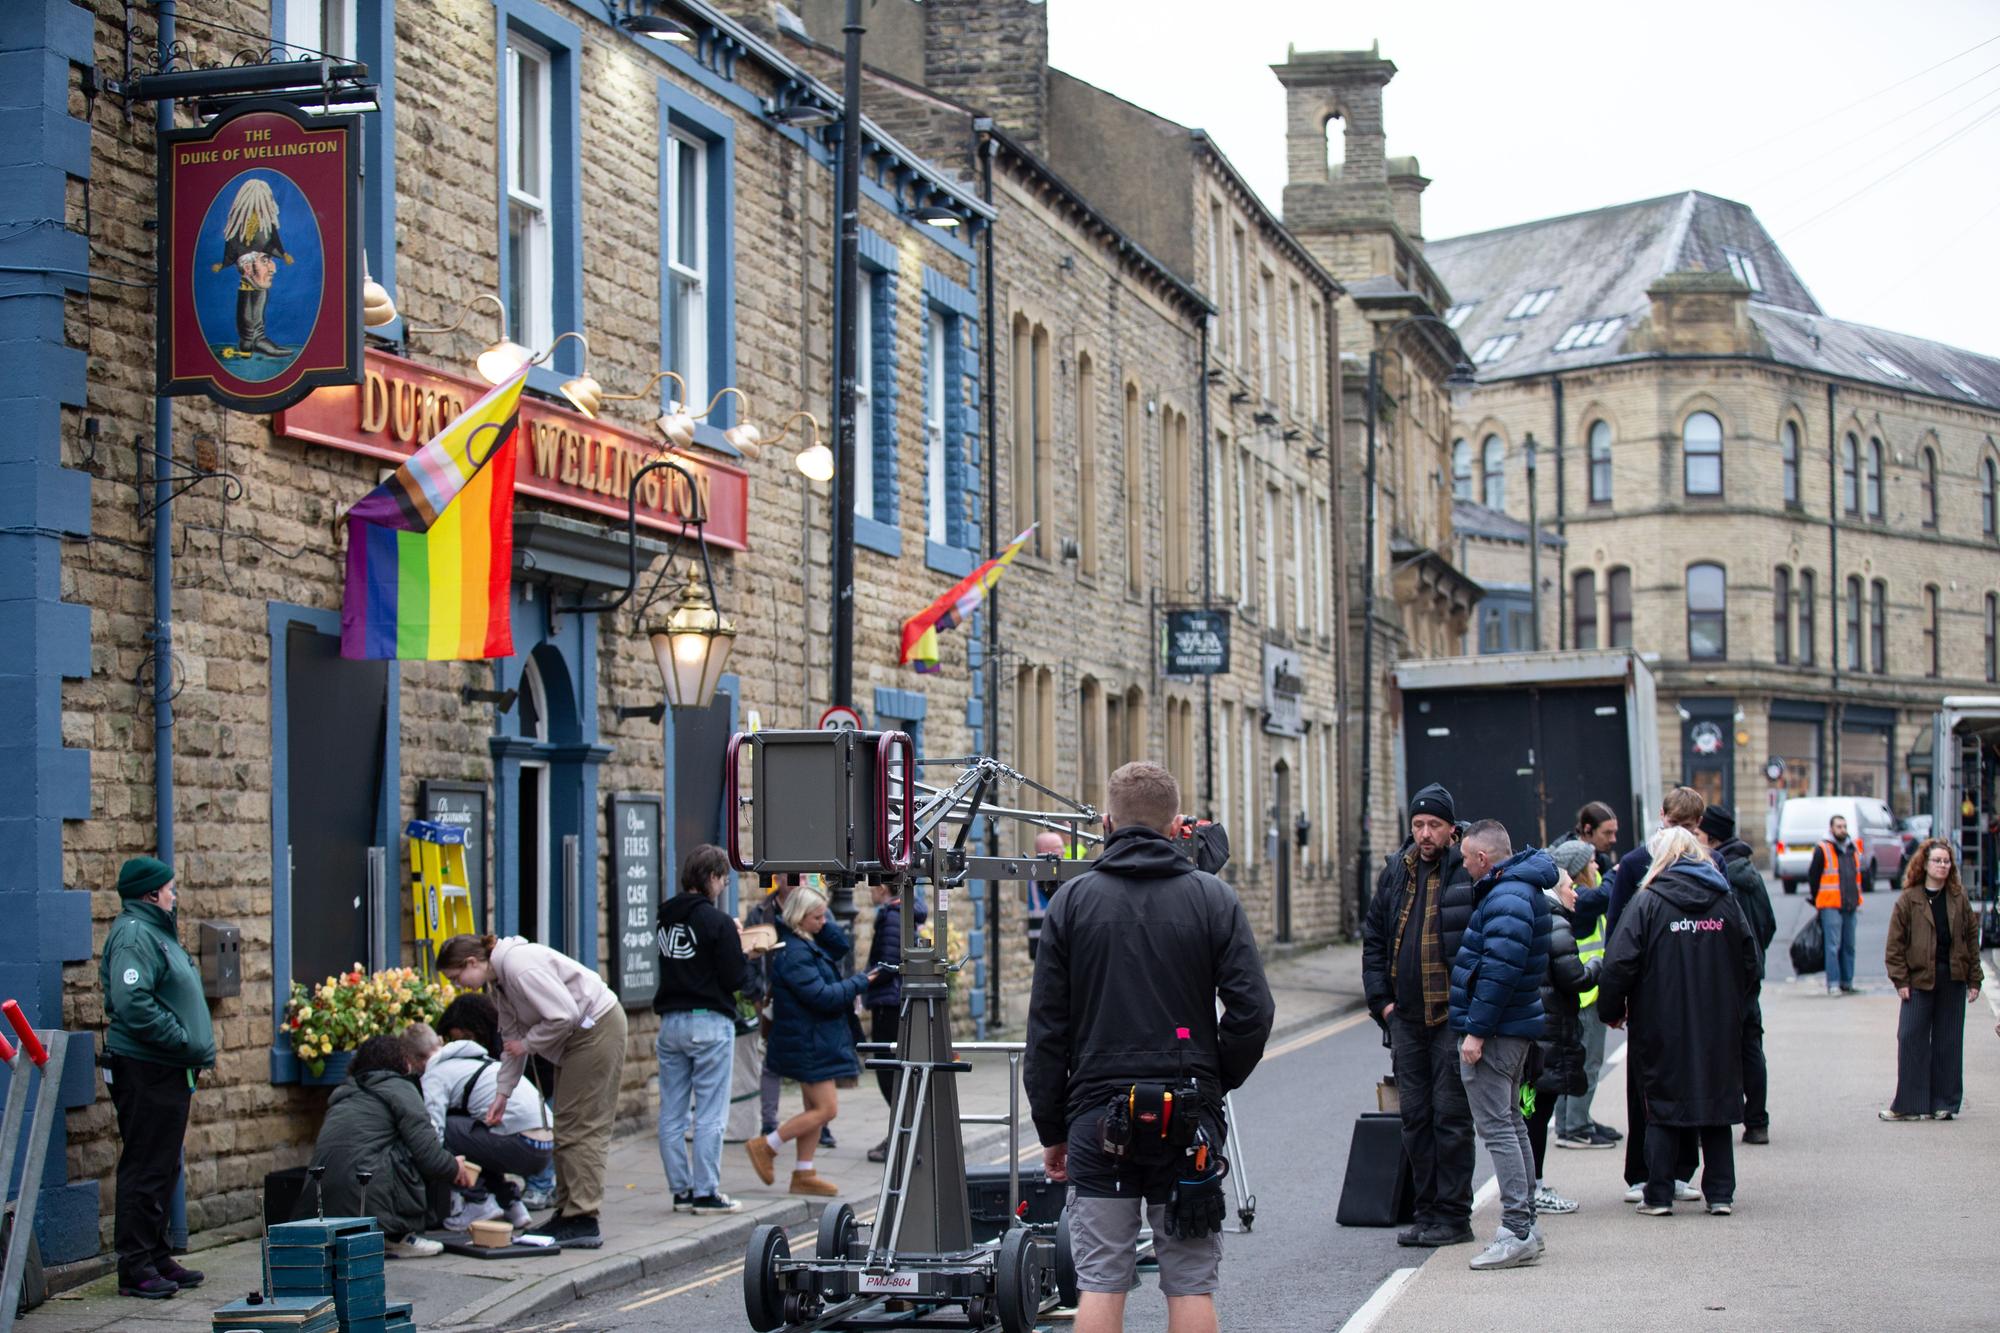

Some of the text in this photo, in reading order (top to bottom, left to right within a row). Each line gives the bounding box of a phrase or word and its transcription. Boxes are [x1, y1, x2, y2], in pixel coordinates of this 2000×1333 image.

[244, 128, 271, 142] THE
[180, 140, 337, 165] DUKE OF WELLINGTON
[624, 836, 649, 856] FIRES
[627, 884, 648, 905] CASK
[627, 906, 648, 928] ALES
[1680, 918, 1723, 933] dryrobe
[865, 1277, 911, 1287] PMJ-804
